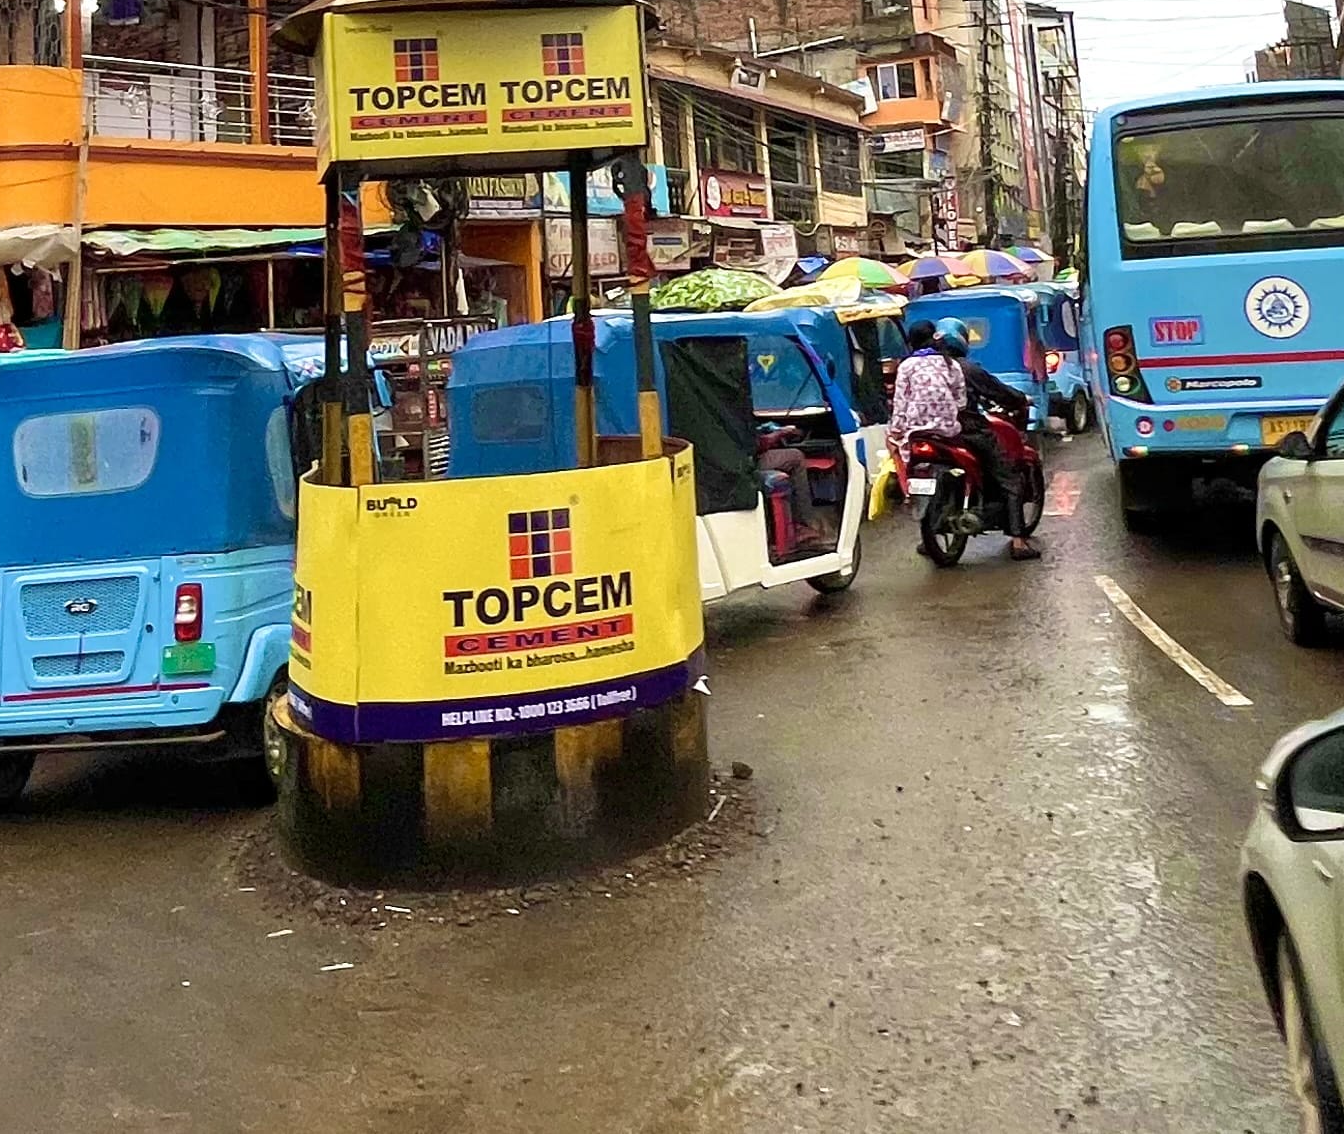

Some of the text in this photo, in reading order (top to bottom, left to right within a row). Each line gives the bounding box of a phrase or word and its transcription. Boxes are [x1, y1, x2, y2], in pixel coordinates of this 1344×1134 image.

[349, 77, 631, 111] TOPCEM TOPCEM
[357, 112, 479, 127] CEMENT
[508, 106, 625, 121] CEMENT
[1154, 320, 1199, 342] STOP
[1185, 377, 1257, 389] Marcopolo
[443, 571, 633, 627] TOPCEM
[457, 619, 623, 653] CEMENT
[444, 656, 503, 675] Mazbooti
[507, 655, 523, 670] ka
[441, 708, 494, 727] HELPLINE
